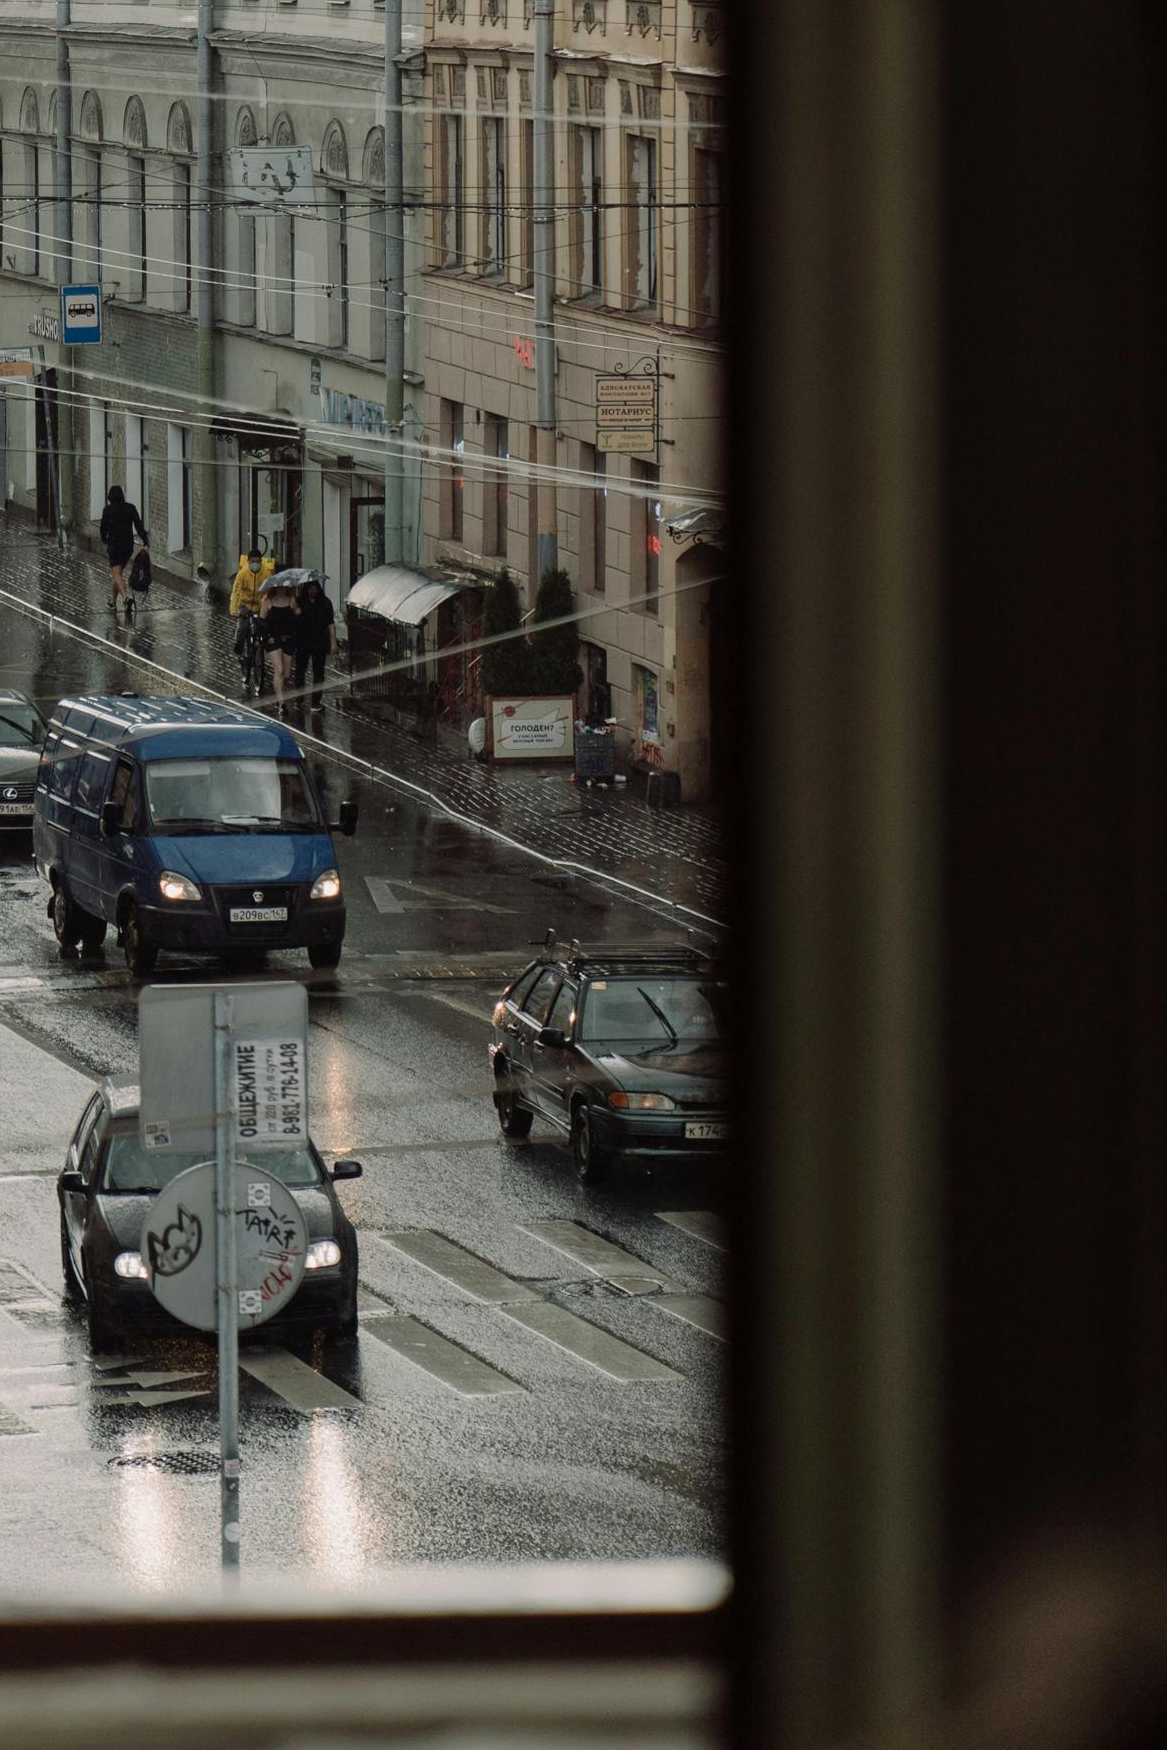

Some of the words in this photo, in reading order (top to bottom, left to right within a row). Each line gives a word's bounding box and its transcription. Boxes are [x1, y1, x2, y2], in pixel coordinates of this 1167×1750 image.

[601, 408, 652, 416] НОТАРИУС
[510, 724, 554, 733] ГОЛОДЕН?
[237, 1045, 260, 1137] ОБЩЕЖИТИЕ
